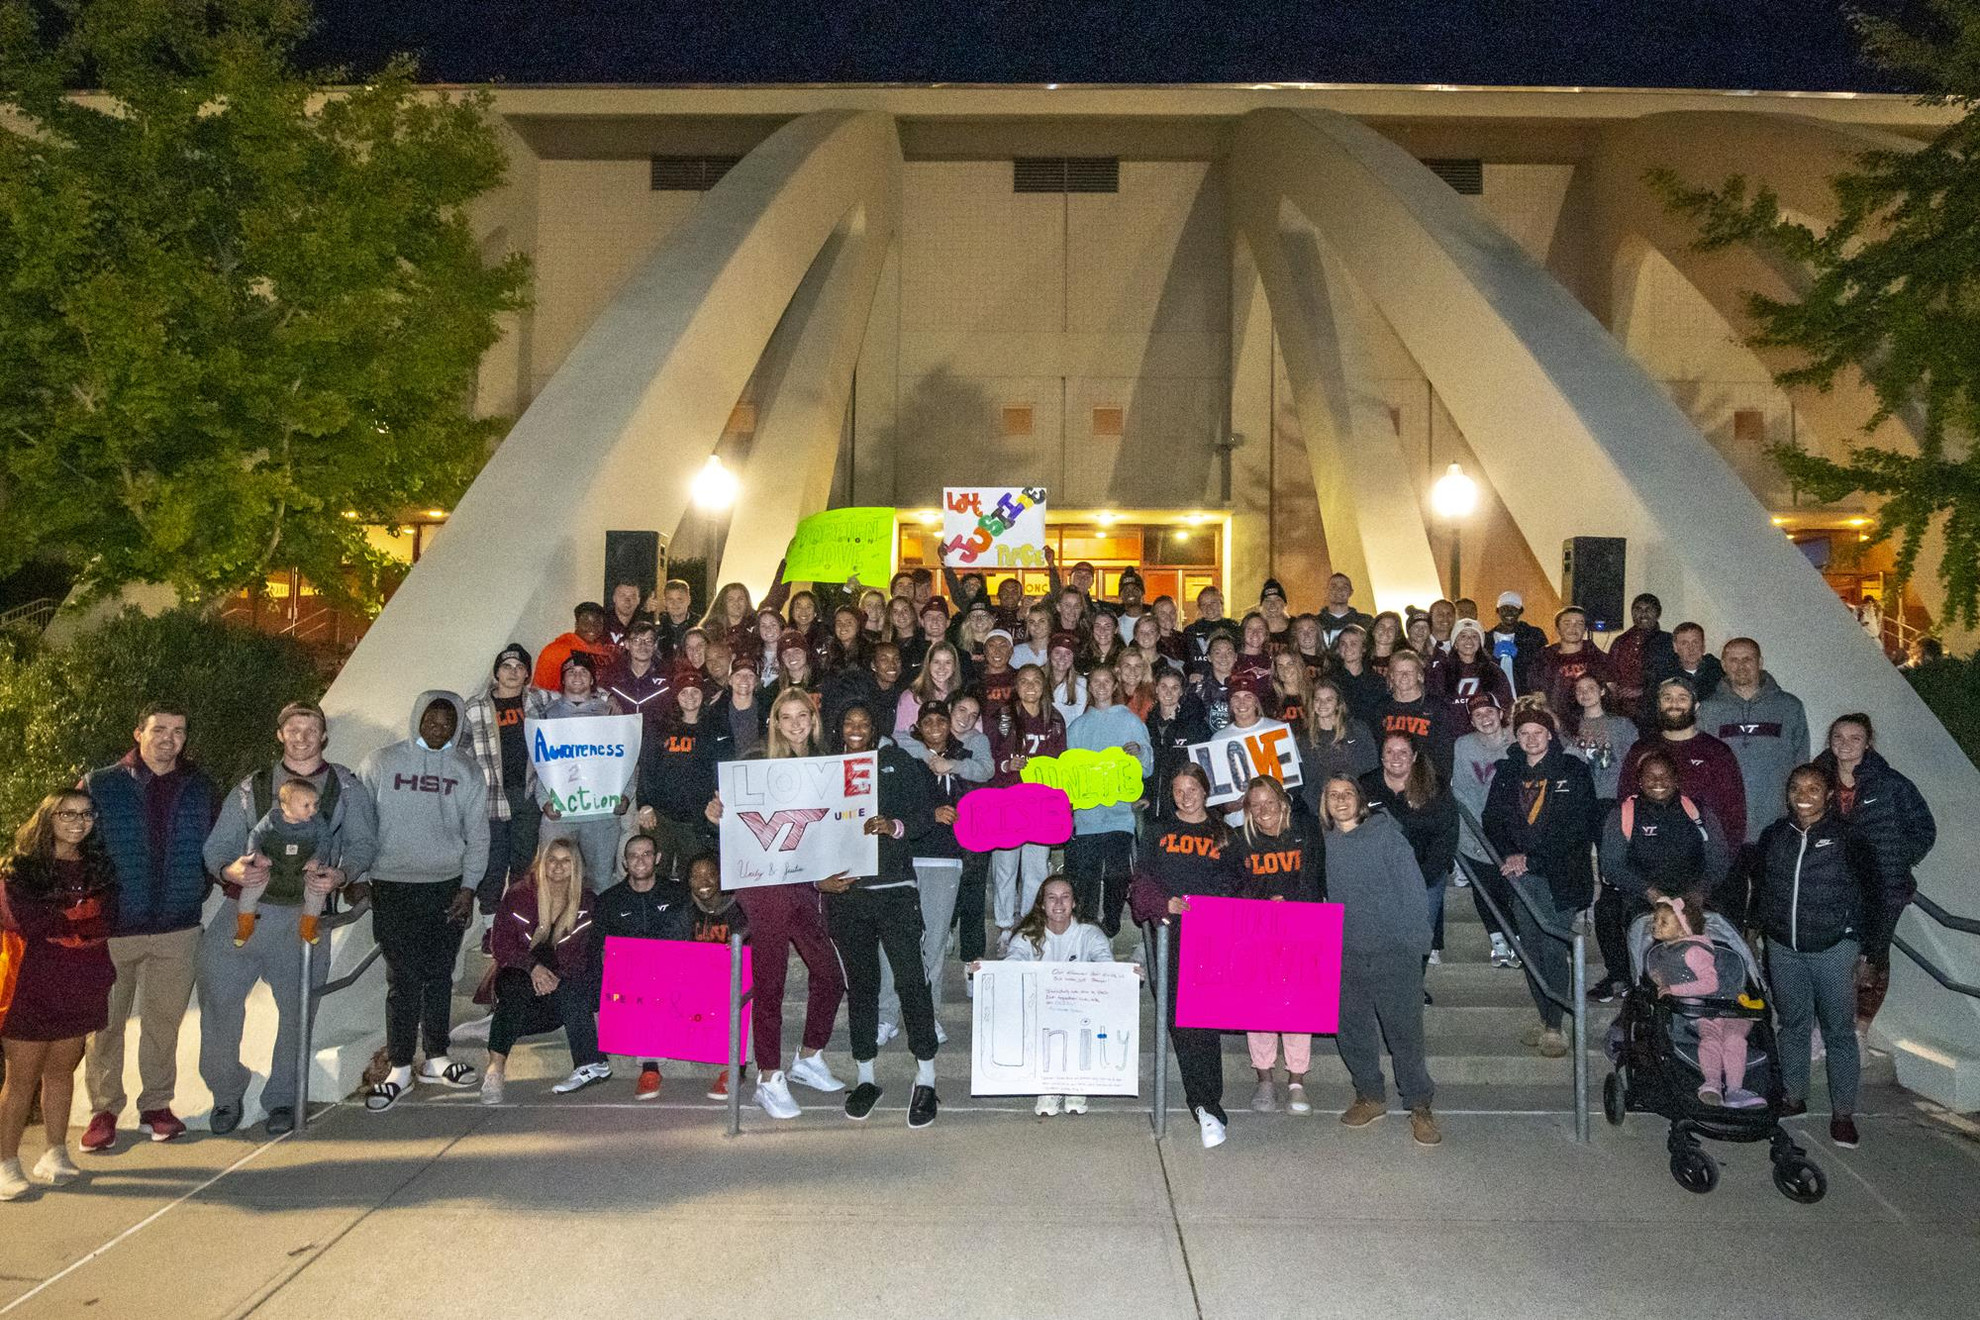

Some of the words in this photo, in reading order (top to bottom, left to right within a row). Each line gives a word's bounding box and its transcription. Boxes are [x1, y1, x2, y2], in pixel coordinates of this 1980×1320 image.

[535, 727, 624, 763] Awareness
[393, 773, 459, 796] HST
[732, 757, 874, 807] LOVE
[834, 807, 866, 821] UNITE
